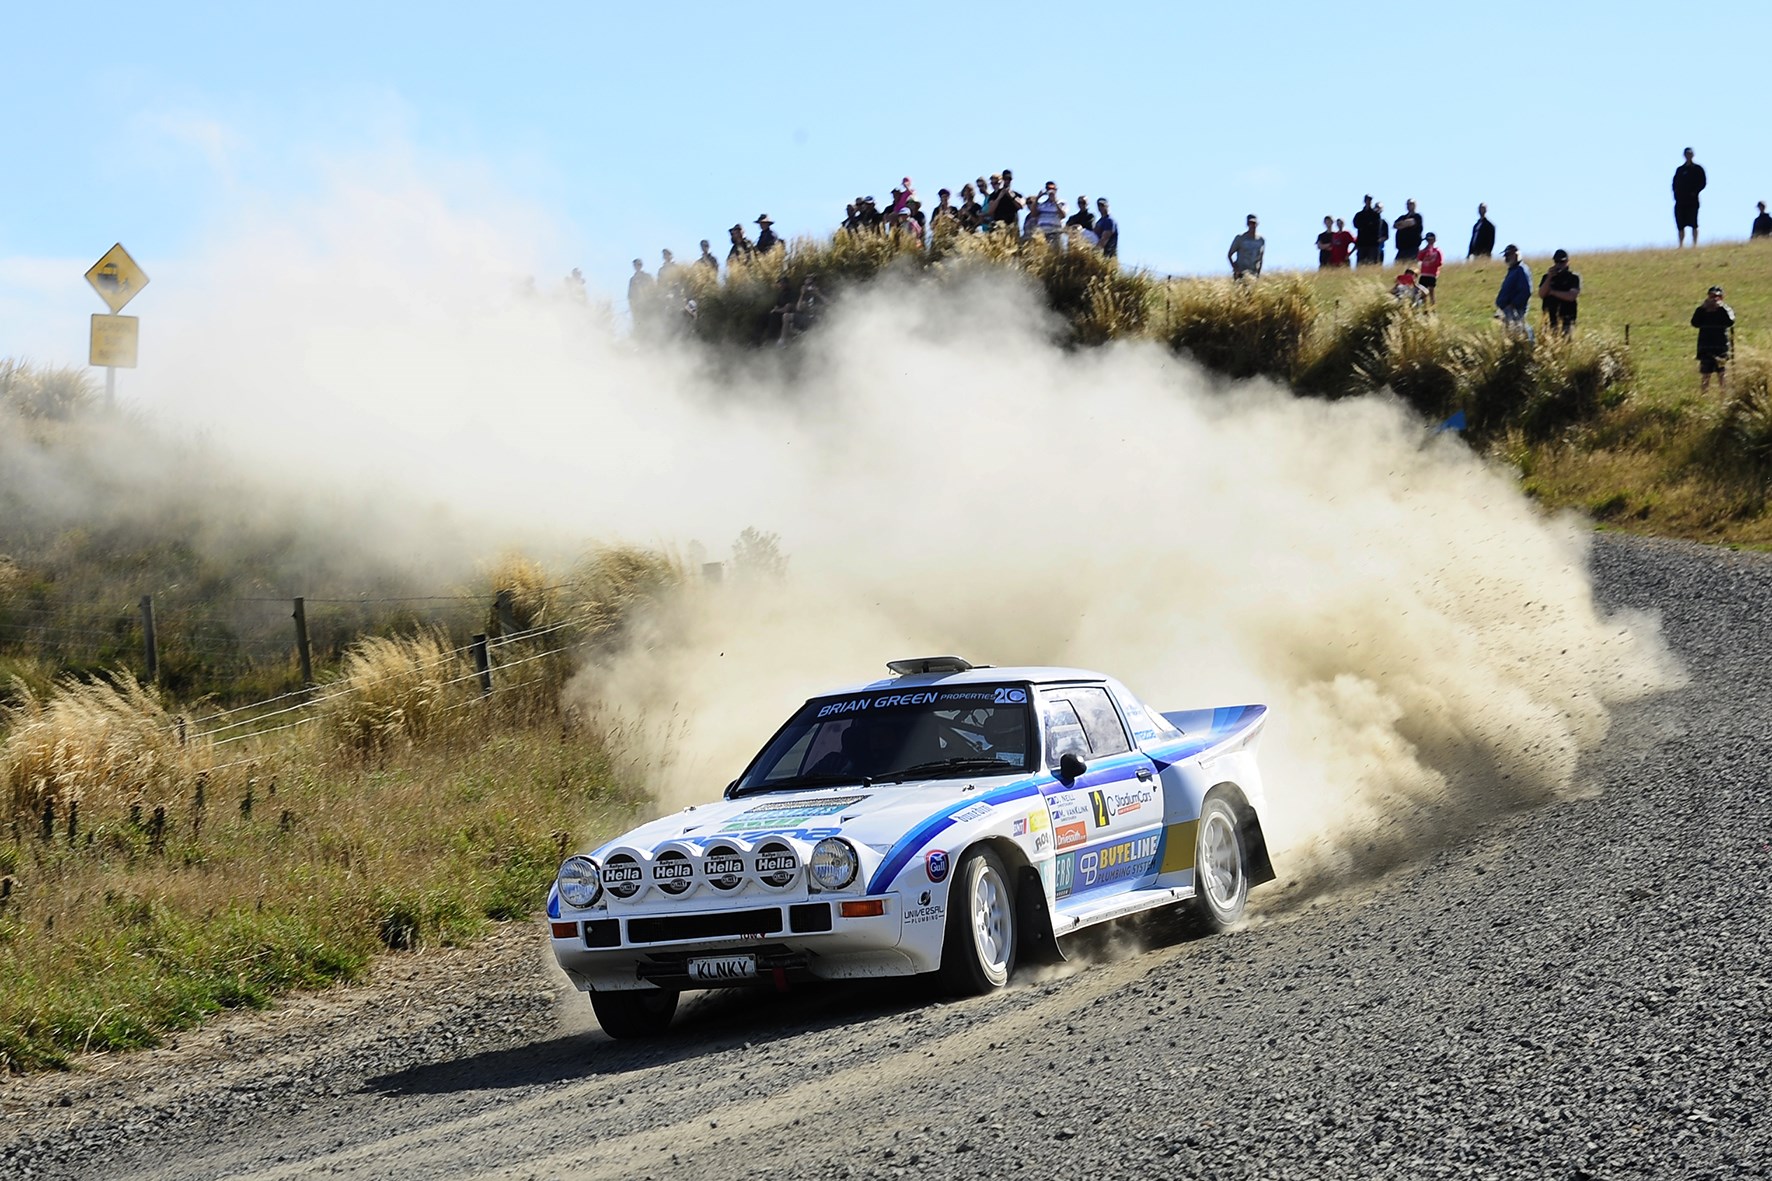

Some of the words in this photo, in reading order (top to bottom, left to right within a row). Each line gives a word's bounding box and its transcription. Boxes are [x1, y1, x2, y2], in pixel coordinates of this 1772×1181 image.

[817, 698, 871, 718] BRIAN
[874, 692, 939, 708] GREEN
[940, 692, 995, 700] PROPERTIES
[1093, 791, 1107, 827] 2
[1100, 835, 1158, 869] BUTELINE
[656, 864, 691, 878] Hella
[706, 860, 741, 874] Hella
[758, 857, 794, 871] Hella
[930, 861, 945, 874] Gull
[605, 867, 640, 881] Hella
[904, 906, 944, 919] UNIVERSAL
[911, 914, 938, 924] PLUMBING
[697, 960, 748, 979] KLNKY
